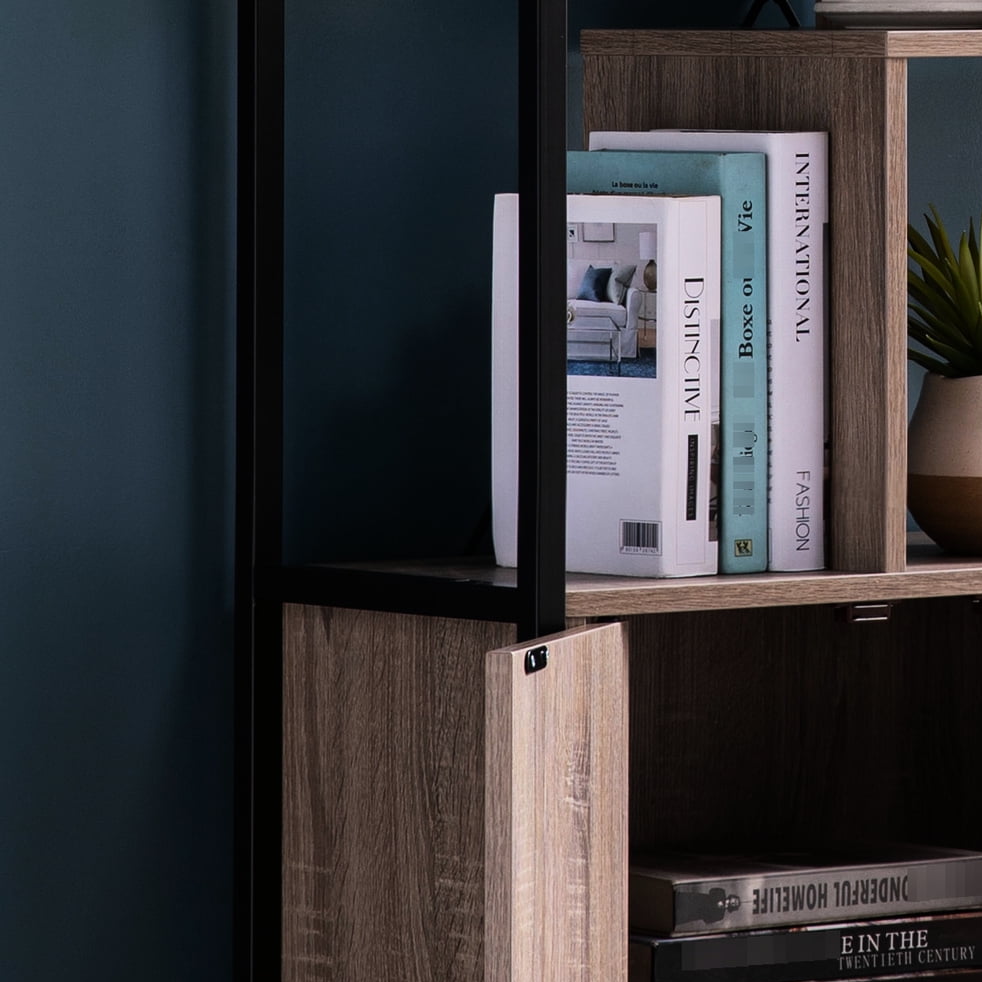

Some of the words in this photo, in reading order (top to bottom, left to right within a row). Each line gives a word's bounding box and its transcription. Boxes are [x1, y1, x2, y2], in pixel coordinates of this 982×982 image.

[738, 200, 753, 232] Vie
[795, 152, 810, 342] INTERNATIONAL
[684, 278, 704, 422] DISTINCTIVE
[738, 304, 753, 359] Boxe
[796, 470, 810, 552] FASHION
[752, 883, 828, 915] HOMELIFE
[838, 951, 912, 971] TWENTIETH
[918, 945, 976, 964] CENTURY
[858, 933, 881, 953] IN
[885, 929, 928, 951] THE
